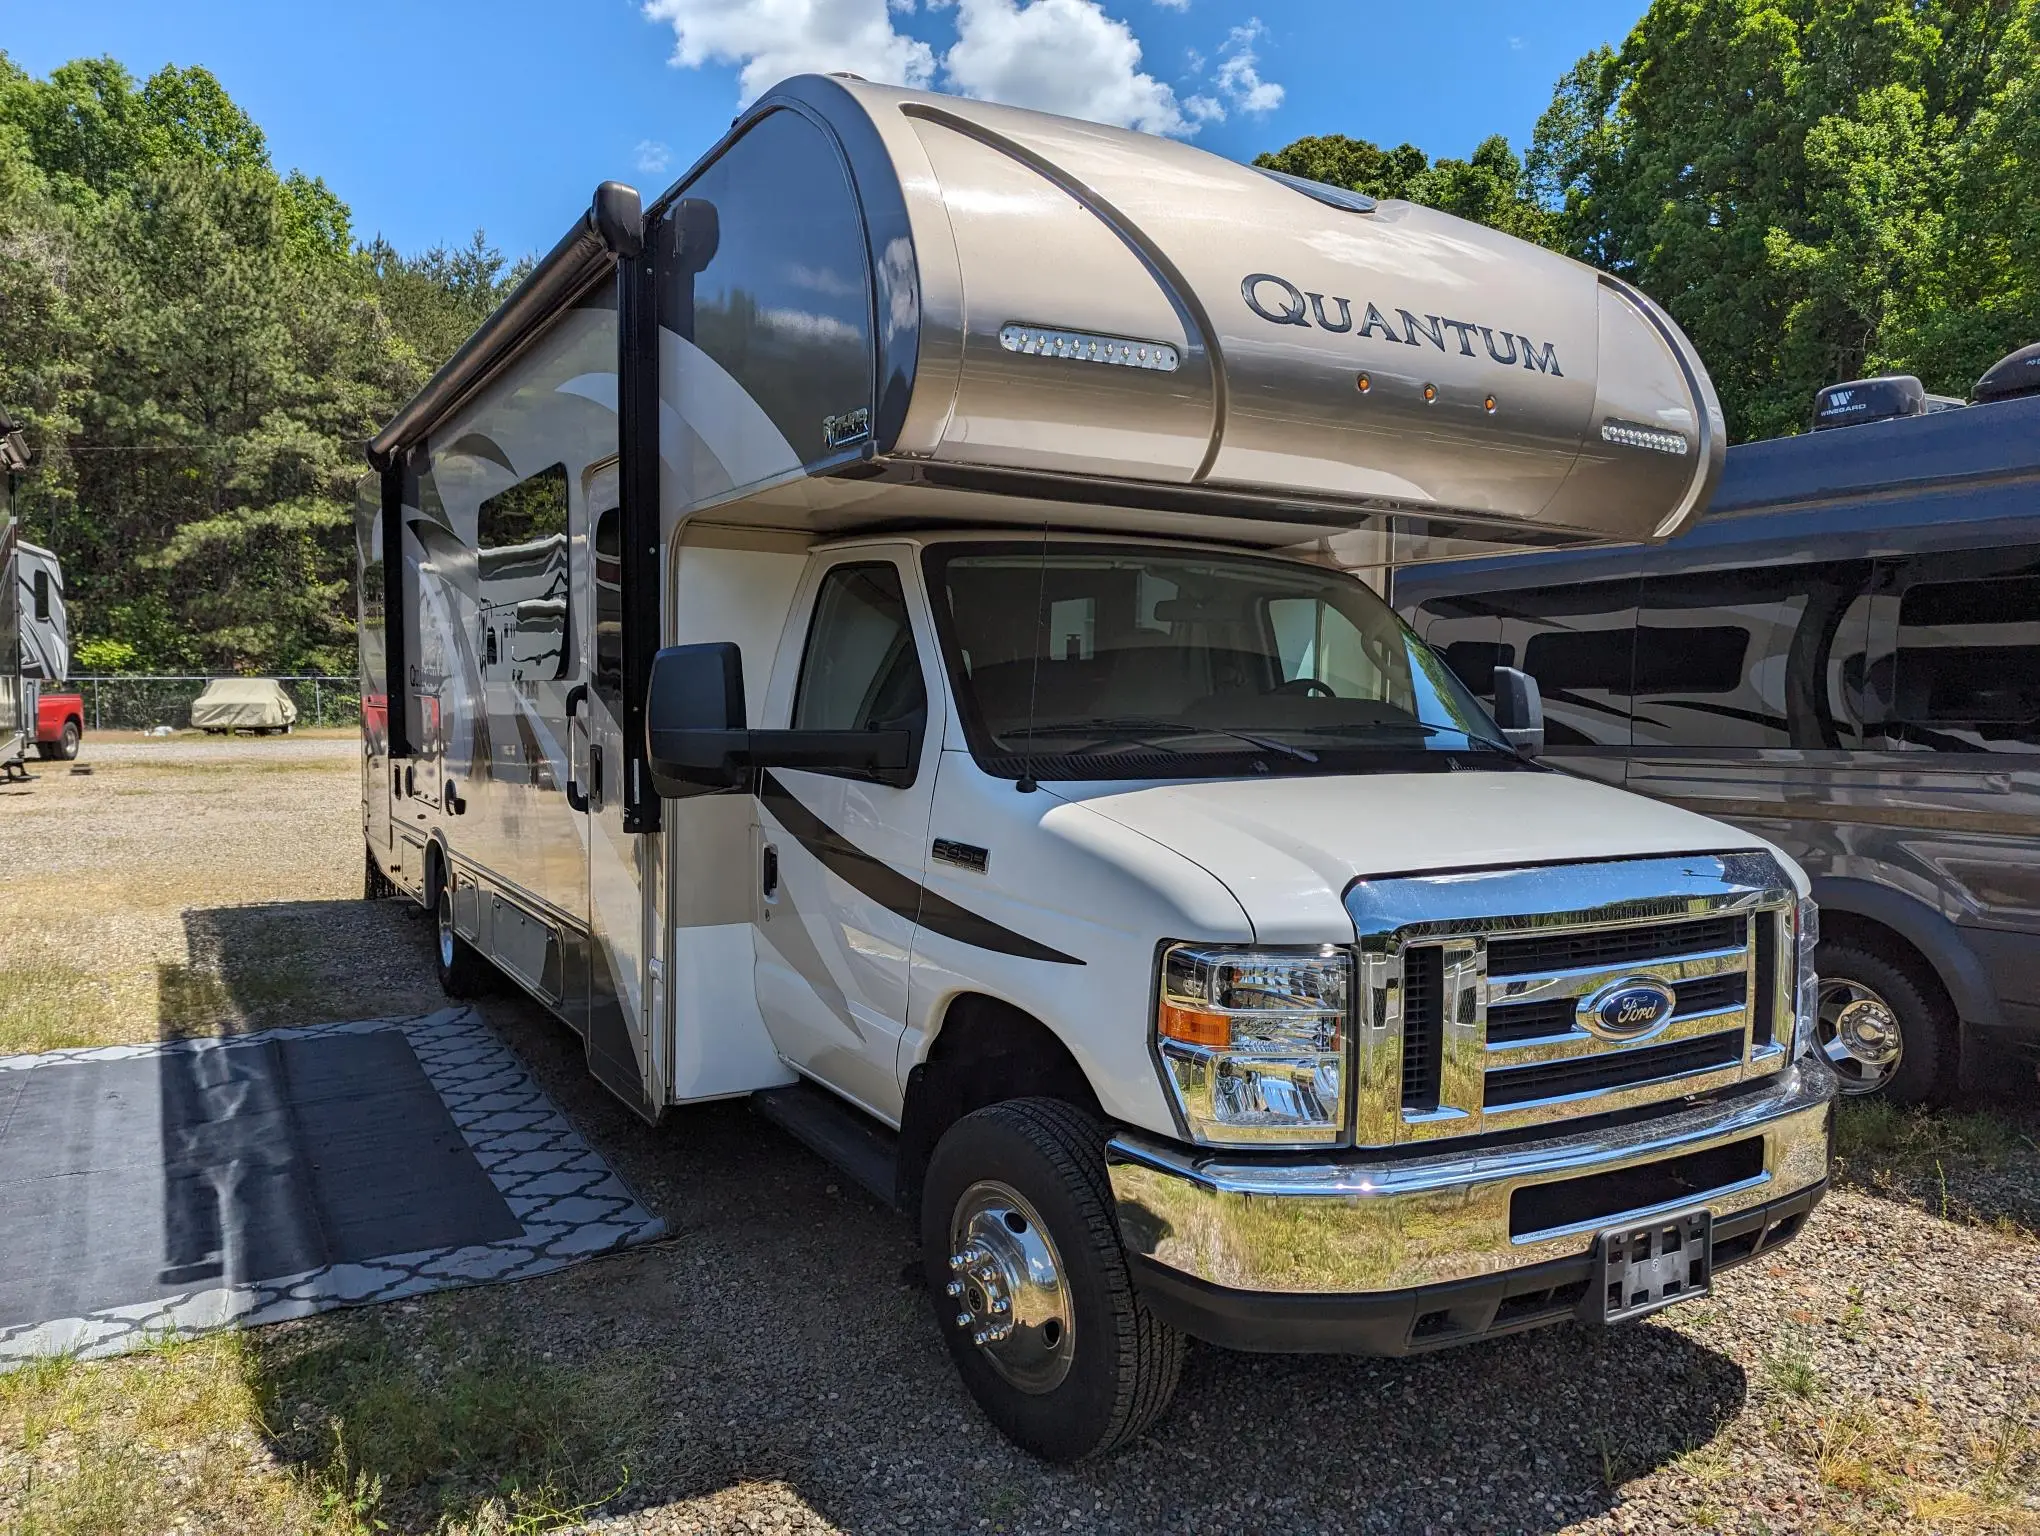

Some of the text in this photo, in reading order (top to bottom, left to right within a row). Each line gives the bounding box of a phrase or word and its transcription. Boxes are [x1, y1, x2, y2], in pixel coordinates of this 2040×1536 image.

[1240, 272, 1565, 378] QUANTUM
[1820, 403, 1867, 417] WINEGARD
[1617, 995, 1658, 1023] Ford
